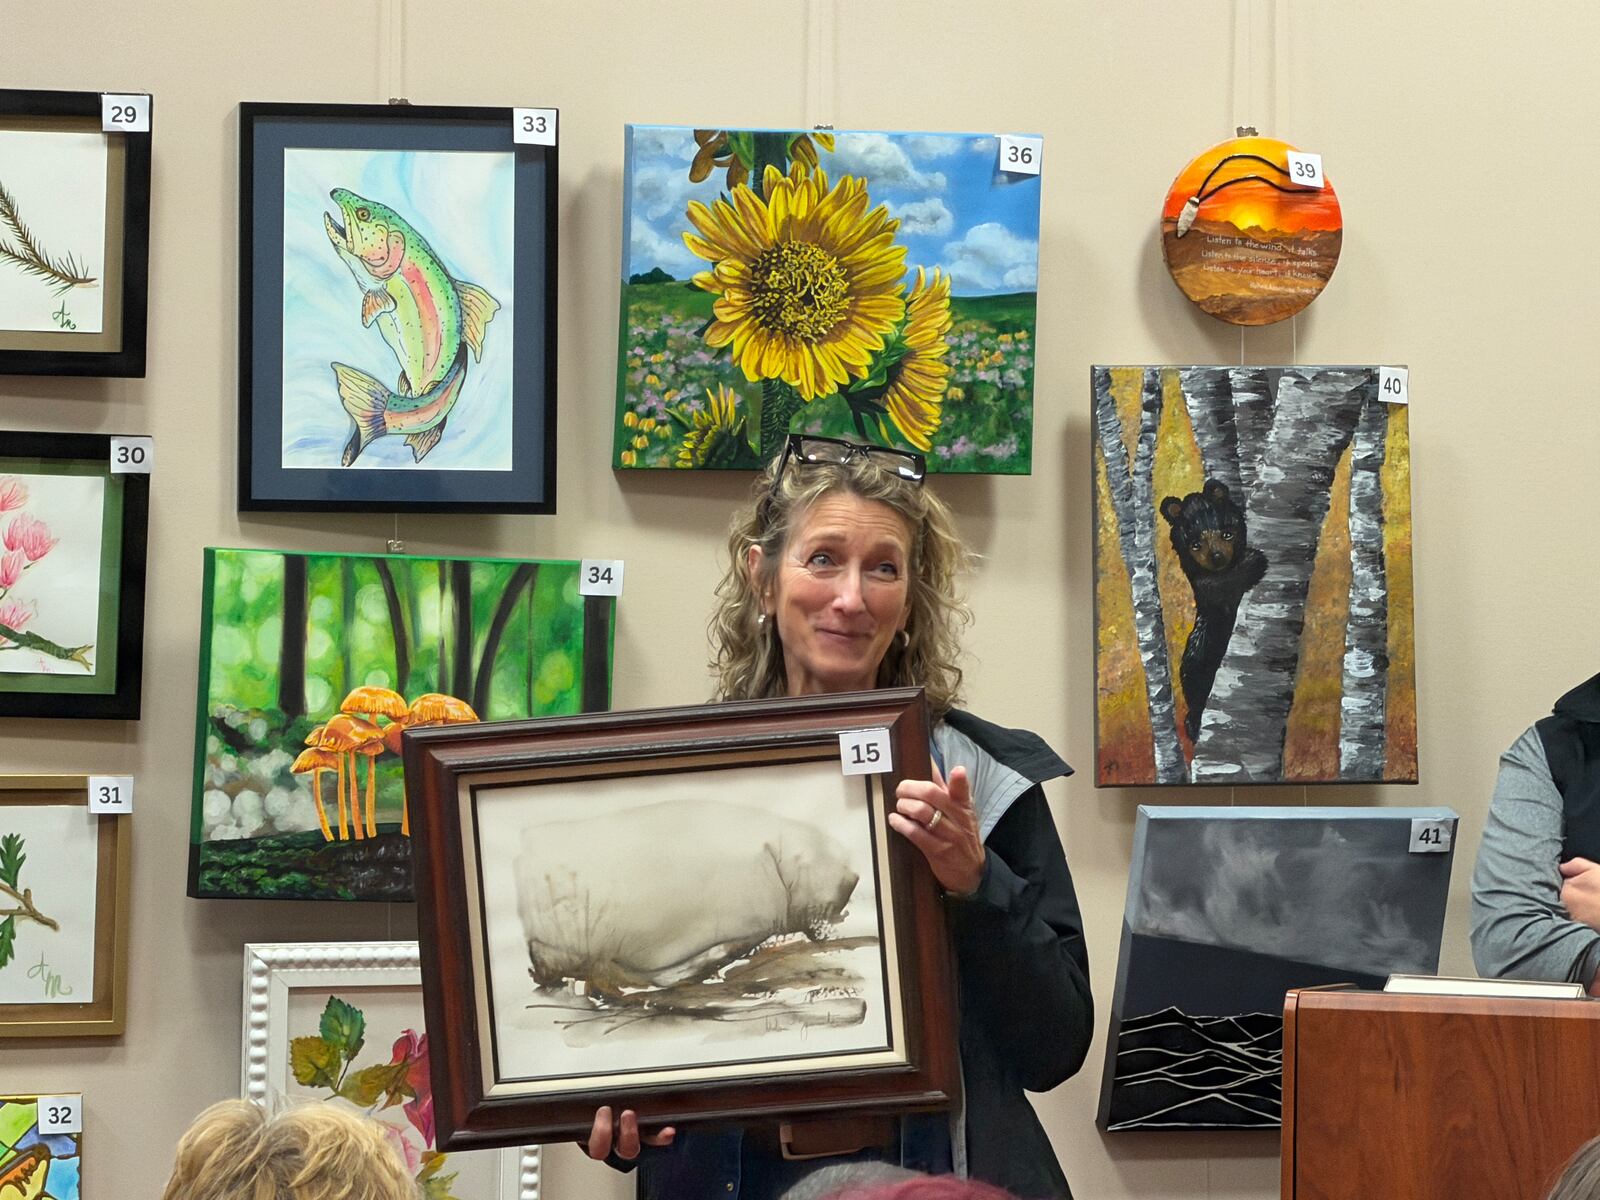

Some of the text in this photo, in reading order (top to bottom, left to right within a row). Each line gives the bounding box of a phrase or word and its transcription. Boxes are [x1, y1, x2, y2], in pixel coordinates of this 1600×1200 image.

[111, 105, 137, 124] 29
[522, 115, 547, 134] 33
[1008, 145, 1033, 165] 36
[1295, 161, 1316, 179] 39
[1206, 234, 1232, 246] Listen
[1235, 236, 1242, 246] to
[1245, 239, 1259, 249] the
[1201, 249, 1224, 259] Listen
[1233, 252, 1247, 260] the
[1202, 263, 1225, 273] Listen
[1237, 266, 1253, 277] your
[1383, 376, 1402, 395] 40
[117, 446, 145, 465] 30
[588, 566, 614, 585] 34
[851, 742, 881, 765] 15
[99, 786, 123, 804] 31
[1418, 827, 1443, 845] 41
[48, 1106, 72, 1125] 32
